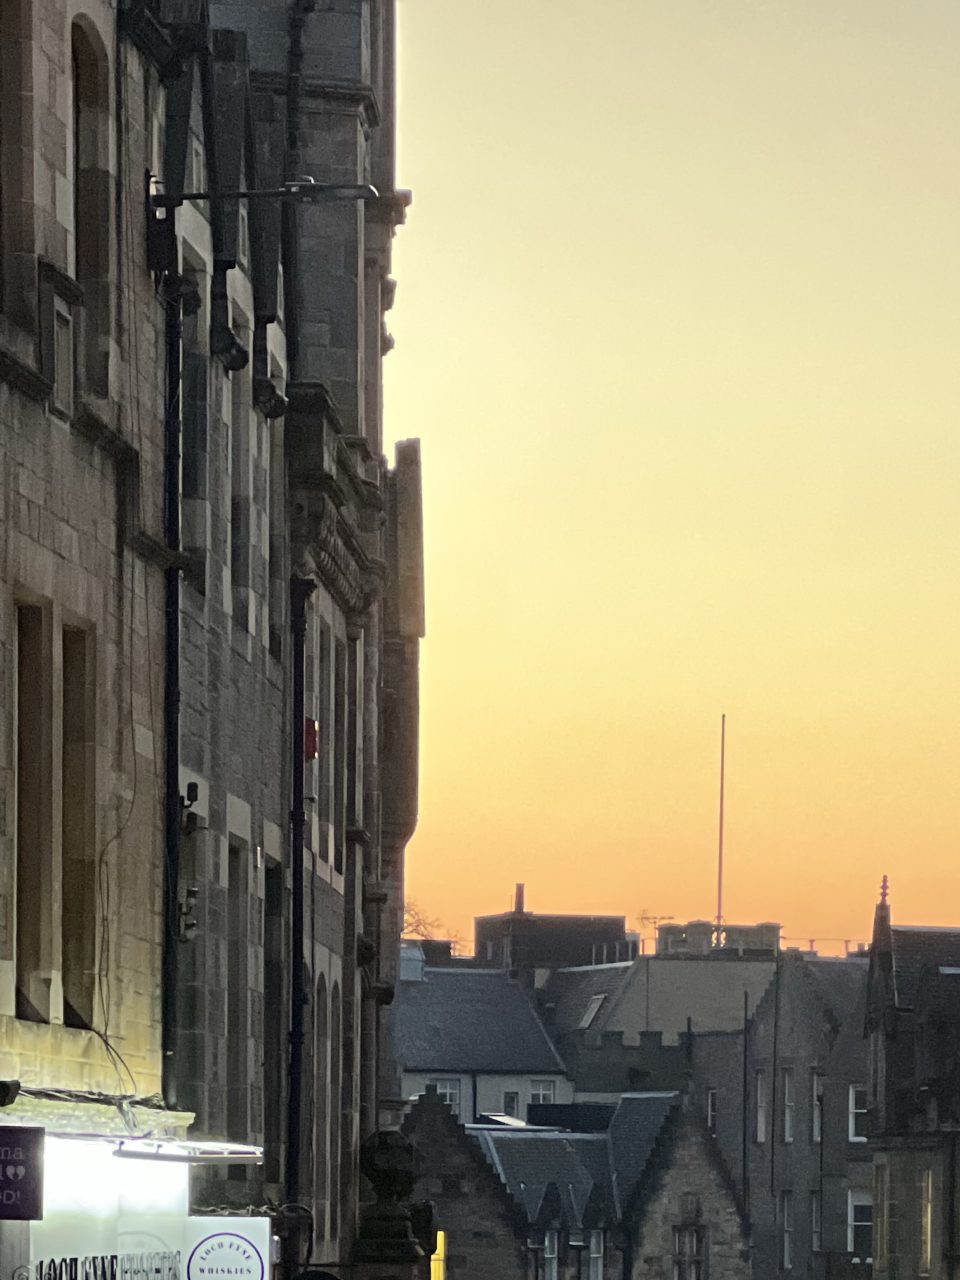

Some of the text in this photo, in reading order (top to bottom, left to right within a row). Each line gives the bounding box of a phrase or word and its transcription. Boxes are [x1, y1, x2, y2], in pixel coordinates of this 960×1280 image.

[200, 1242, 252, 1261] LOCH FYNE
[199, 1267, 252, 1275] WHISKIES
